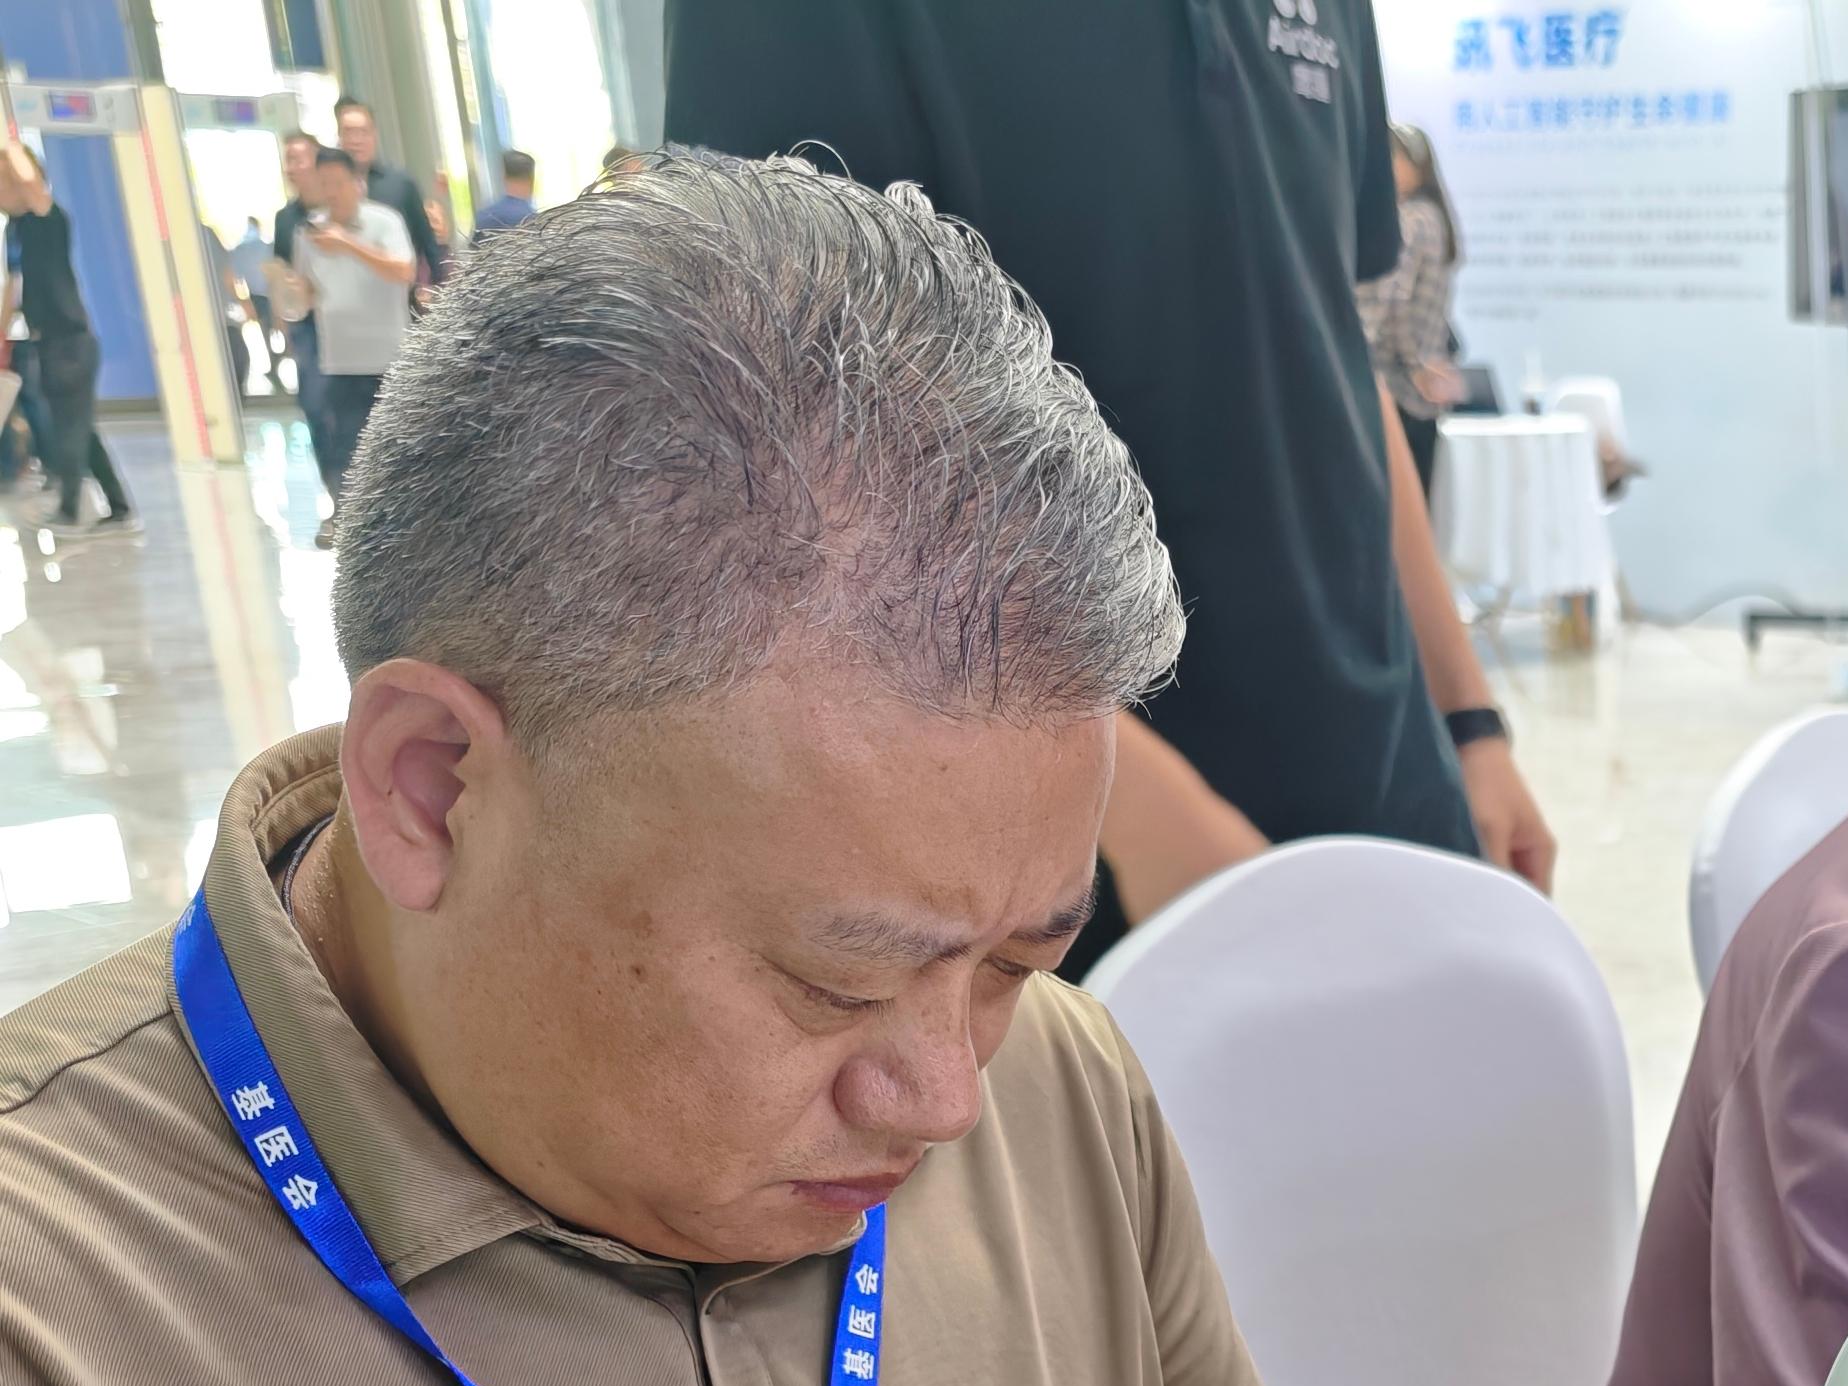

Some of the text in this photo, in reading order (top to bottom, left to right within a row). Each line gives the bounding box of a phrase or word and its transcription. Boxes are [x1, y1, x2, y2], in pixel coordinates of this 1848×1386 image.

[231, 1080, 318, 1210] 基医会
[842, 1263, 880, 1380] 基医会
